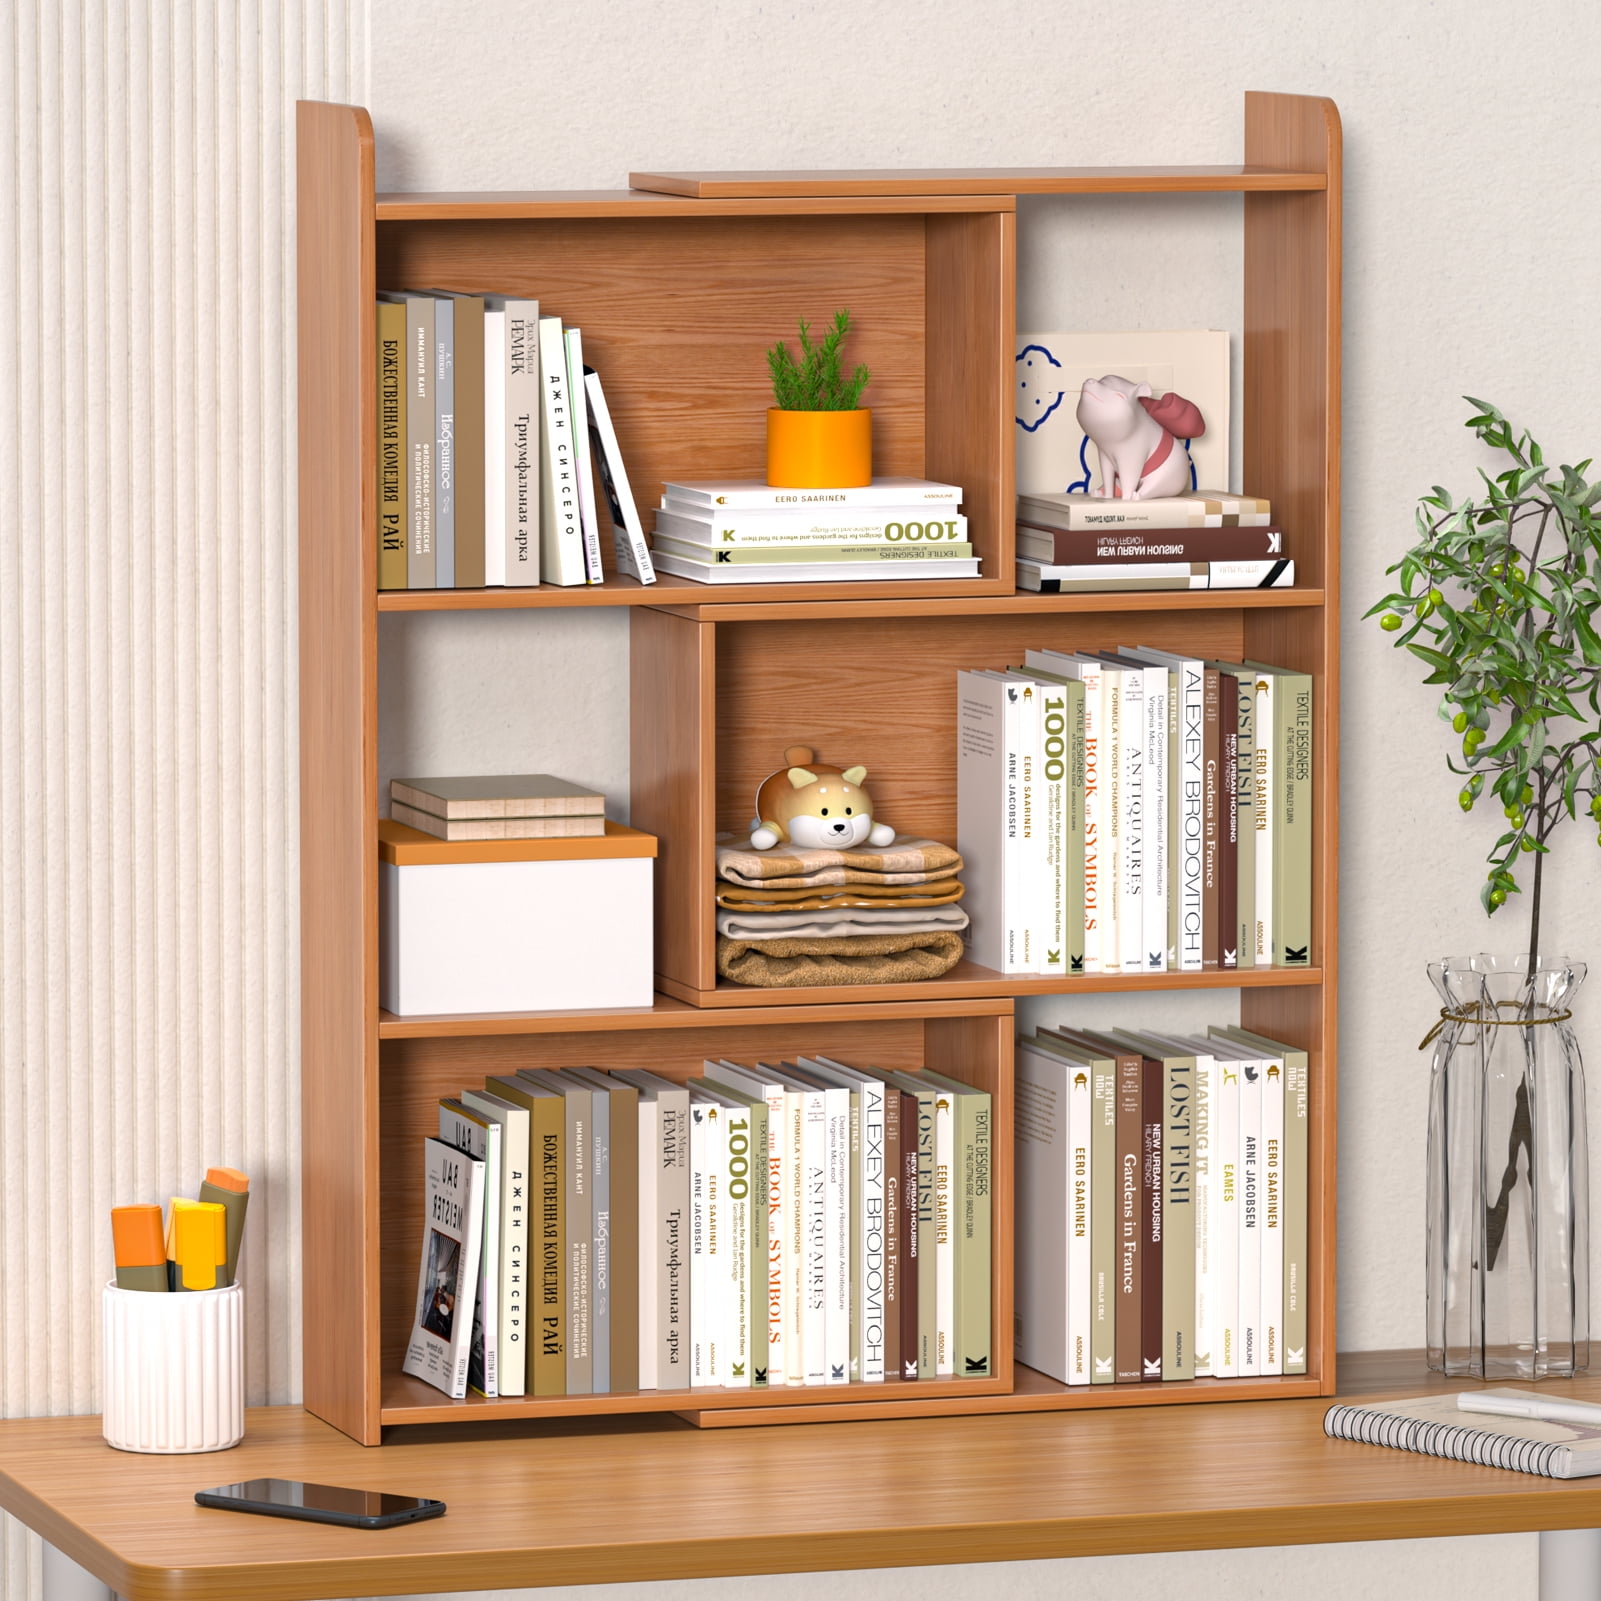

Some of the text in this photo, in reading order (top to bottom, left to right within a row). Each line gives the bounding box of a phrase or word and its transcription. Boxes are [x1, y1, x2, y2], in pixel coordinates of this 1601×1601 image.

[417, 327, 426, 374] ИММАНУИЛ
[511, 320, 524, 374] РЕМАРК
[380, 340, 404, 551] БОЖЕСТВЕННАЯ КОМЕДИЯ РАЙ
[514, 413, 531, 562] Триумфальная арка
[550, 376, 574, 534] ДЖЕН СИНСЕРО
[880, 551, 924, 559] DESIGNERS
[884, 521, 958, 541] 1000
[1045, 697, 1064, 781] 1000
[1186, 670, 1201, 771] ALEXEY
[1238, 682, 1252, 806] LOST FISH
[1296, 691, 1309, 780] TEXTILE DESIGNERS
[1085, 738, 1097, 798] BOOK
[1256, 749, 1266, 830] EERO SAARINEN
[1129, 748, 1141, 895] ANTIQUAIRES
[1185, 781, 1201, 950] BRODOVITCH
[1206, 760, 1216, 888] Gardens in France
[1085, 823, 1097, 931] SYMBOLS
[1096, 1075, 1104, 1099] NOW
[1105, 1074, 1114, 1126] TEXTILES
[1196, 1070, 1208, 1150] MAKING
[1288, 1067, 1296, 1091] NOW
[1297, 1067, 1306, 1118] TEXTILES
[664, 1111, 676, 1168] РЕМАРК
[729, 1118, 748, 1200] 1000
[867, 1091, 882, 1189] ALEXEY
[919, 1101, 932, 1222] LOST FISH
[976, 1109, 988, 1196] TEXTILE DESIGNERS
[1152, 1151, 1160, 1190] URBAN
[1171, 1067, 1190, 1203] LOST FISH
[1196, 1156, 1208, 1175] IT
[937, 1165, 947, 1244] EERO SAARINEN
[1075, 1148, 1085, 1237] EERO SAARINEN
[1124, 1153, 1136, 1293] Gardens in France
[1152, 1192, 1160, 1242] HOUSING
[1224, 1164, 1234, 1202] EAMES
[1246, 1136, 1256, 1228] ARNE JACOBSEN
[1268, 1139, 1277, 1228] EERO SAARINEN
[511, 1171, 522, 1342] ДЖЕН СИНСЕРО
[542, 1135, 562, 1355] БОЖЕСТВЕННАЯ КОМЕДИЯ РАЙ
[769, 1158, 781, 1344] BOOK SYMBOLS
[812, 1167, 824, 1310] ANTIQUAIRES
[867, 1198, 882, 1362] BRODOVITCH
[888, 1177, 897, 1301] Gardens in France
[666, 1209, 682, 1364] Триумфальная арка
